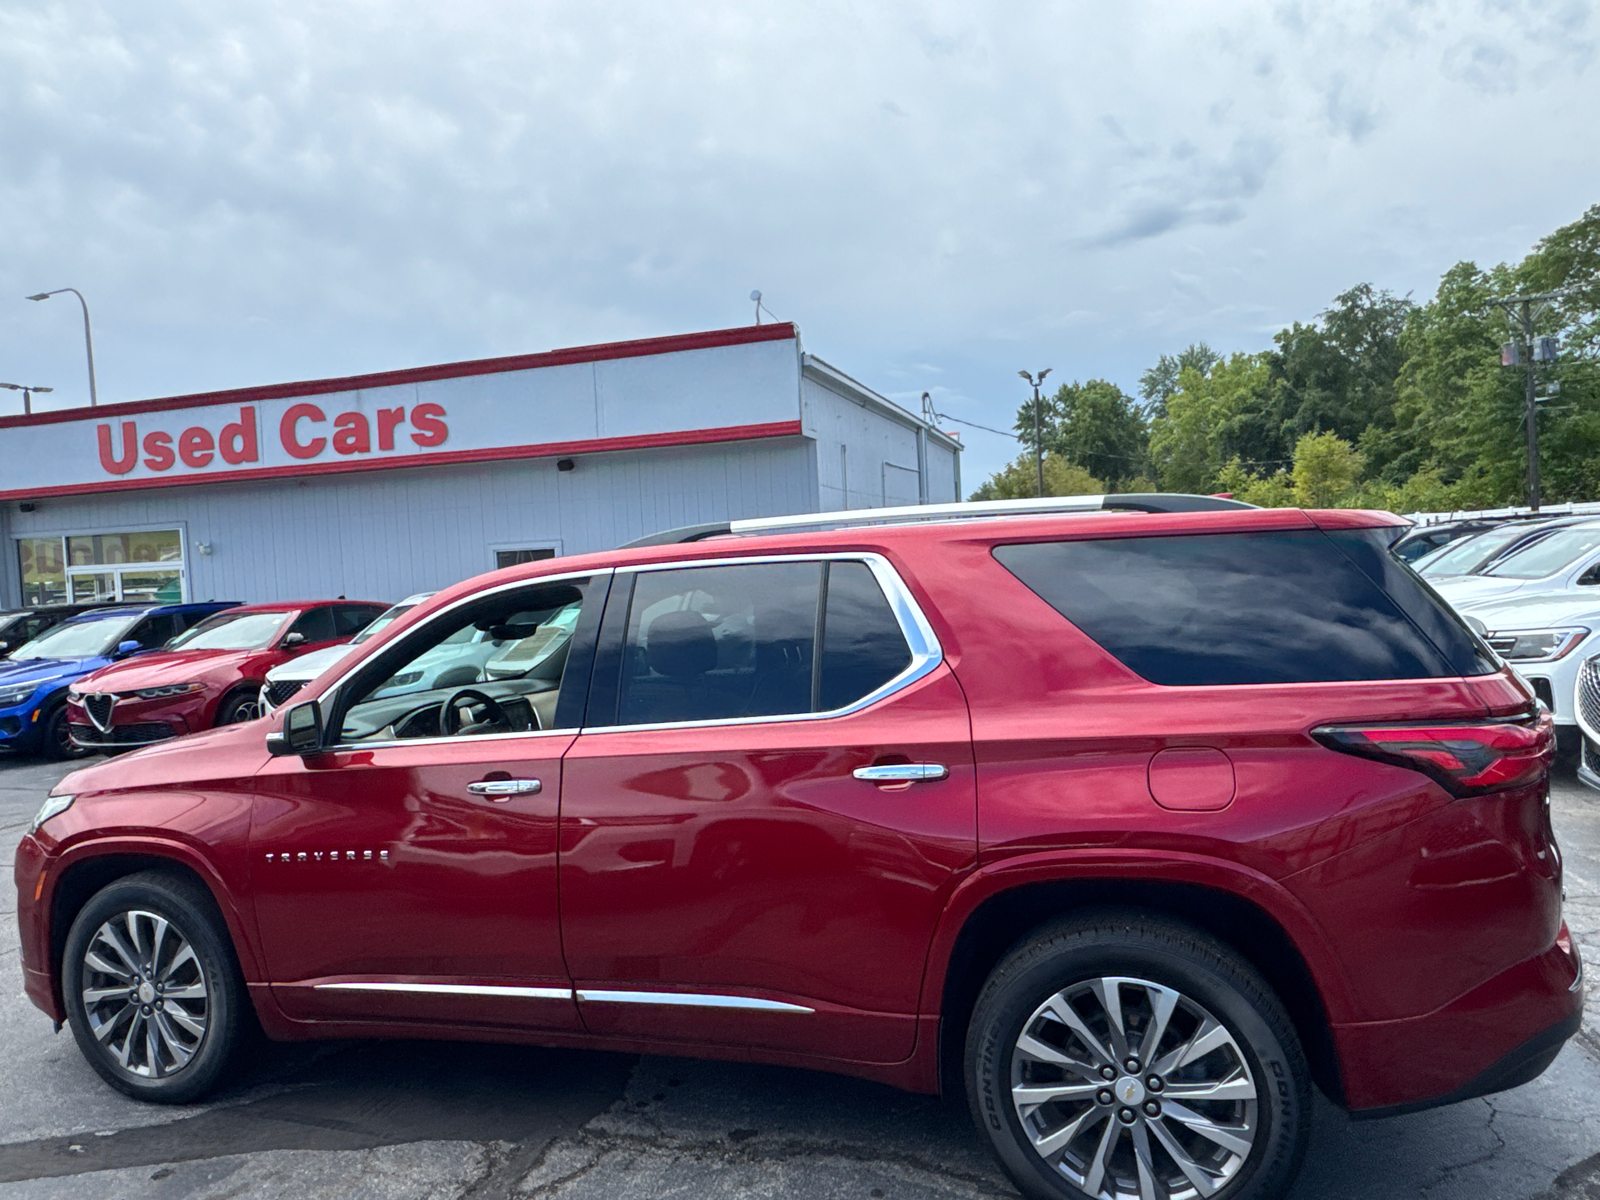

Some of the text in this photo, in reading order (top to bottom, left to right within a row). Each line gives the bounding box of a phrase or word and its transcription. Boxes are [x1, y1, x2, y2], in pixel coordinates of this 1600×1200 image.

[97, 402, 449, 475] Used Cars
[265, 850, 389, 863] TRAVERSE
